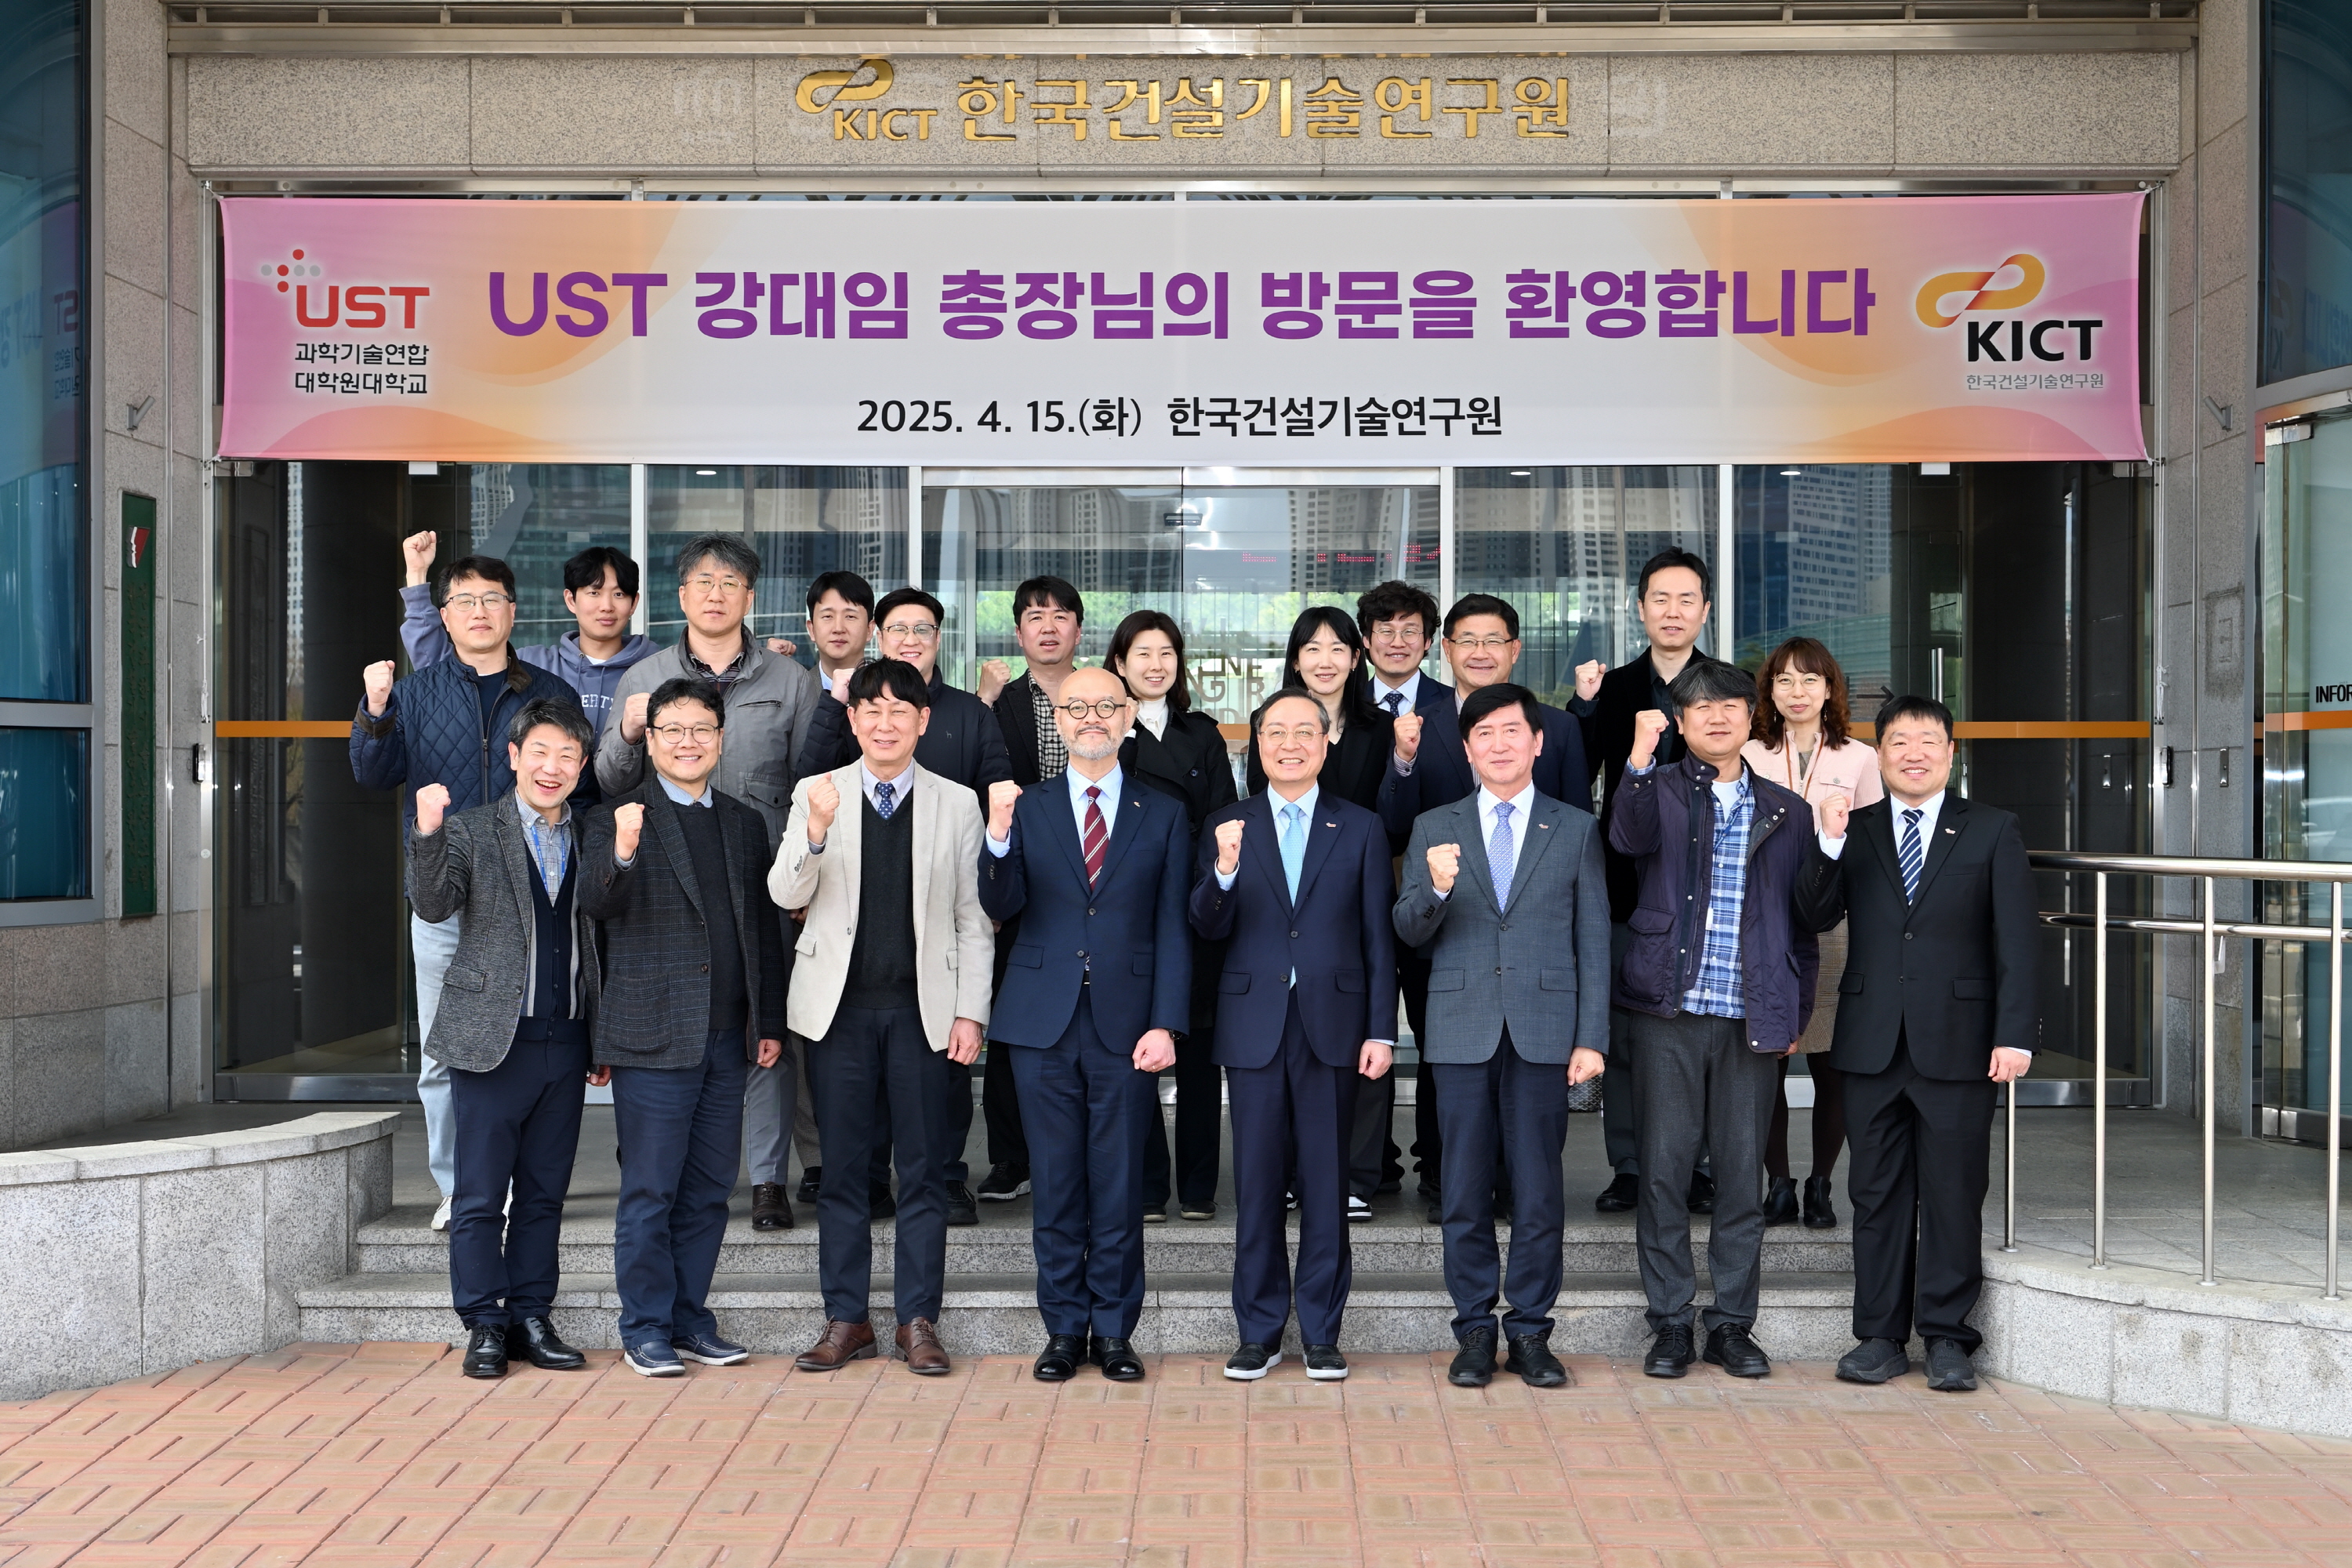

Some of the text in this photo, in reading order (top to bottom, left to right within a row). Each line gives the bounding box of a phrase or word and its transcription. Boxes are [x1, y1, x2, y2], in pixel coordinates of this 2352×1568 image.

[835, 108, 937, 140] KICT
[956, 76, 1569, 142] 한국건설기술연구원
[295, 285, 430, 328] UST
[489, 268, 1877, 340] UST 강대임 총장님의 방문을 환영합니다
[294, 342, 430, 366] 과학기술연합
[1966, 319, 2103, 363] KICT
[294, 372, 428, 395] 대학원대학교
[1965, 372, 2105, 391] 한국건설기술연구원
[857, 396, 1503, 437] 2025. 4. 15.(화) 한국건설기술연구원
